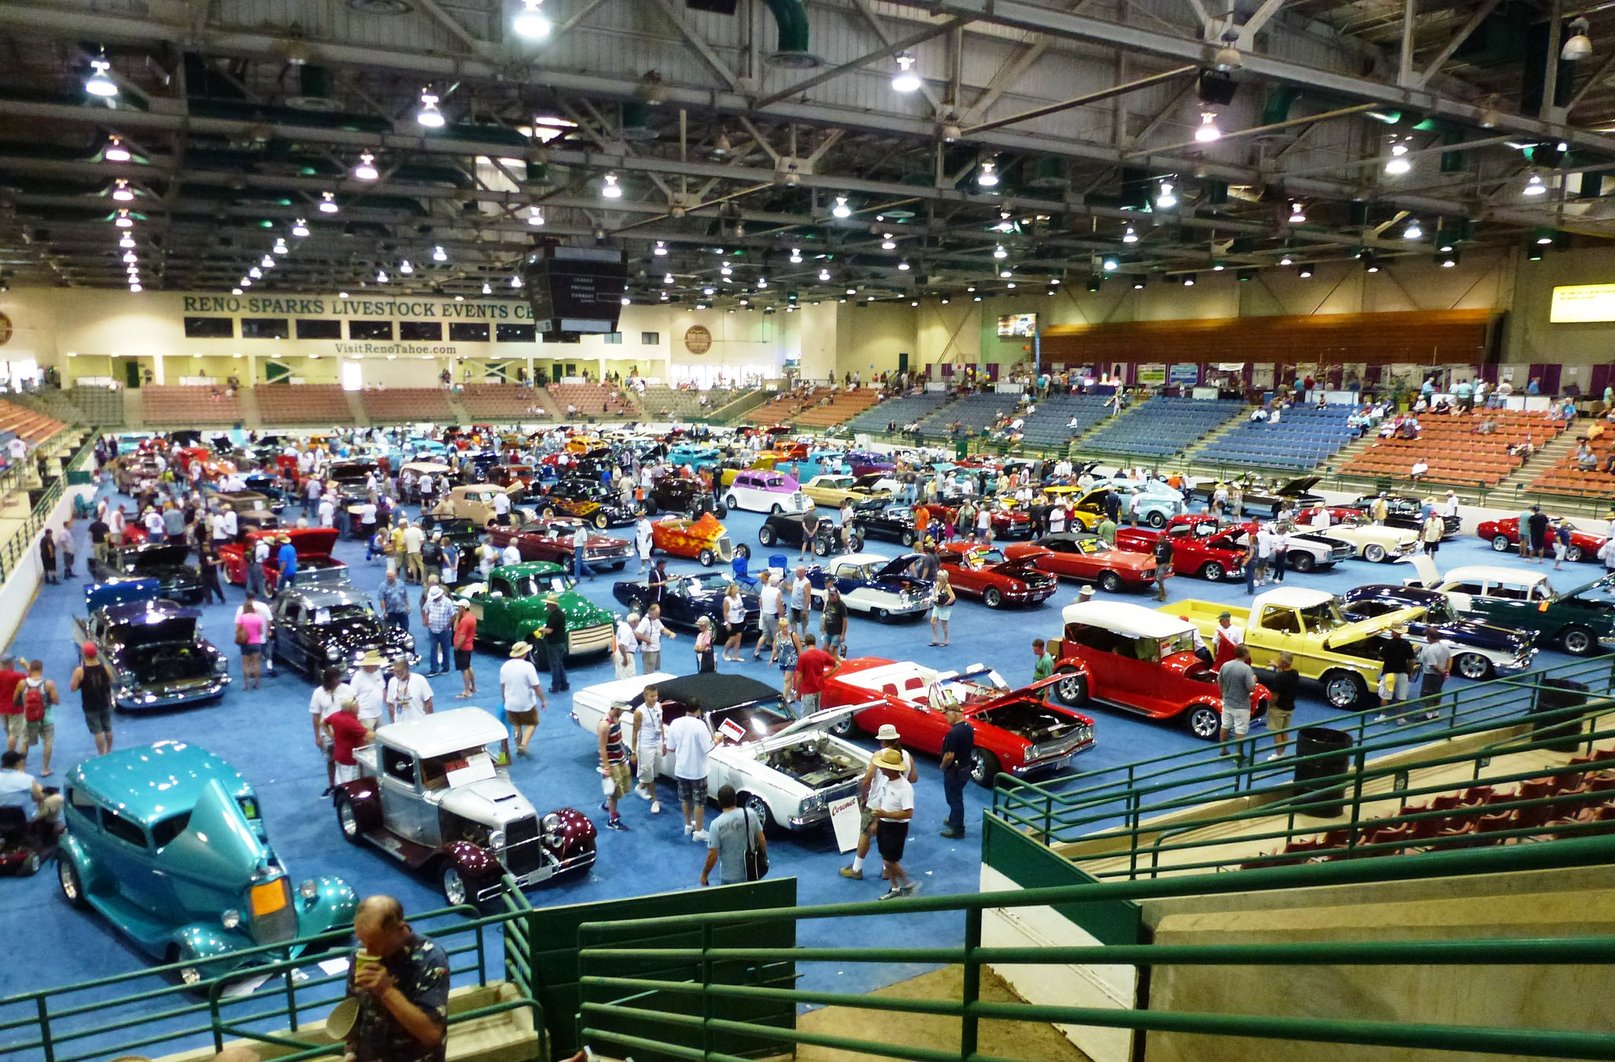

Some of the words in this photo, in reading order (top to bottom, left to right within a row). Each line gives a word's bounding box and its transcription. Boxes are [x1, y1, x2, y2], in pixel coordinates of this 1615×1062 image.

[183, 296, 325, 314] RENO-SPARKS
[332, 300, 436, 317] LIVESTOCK
[441, 303, 509, 318] EVENTS
[335, 343, 457, 354] VisitRenoTahoe.com
